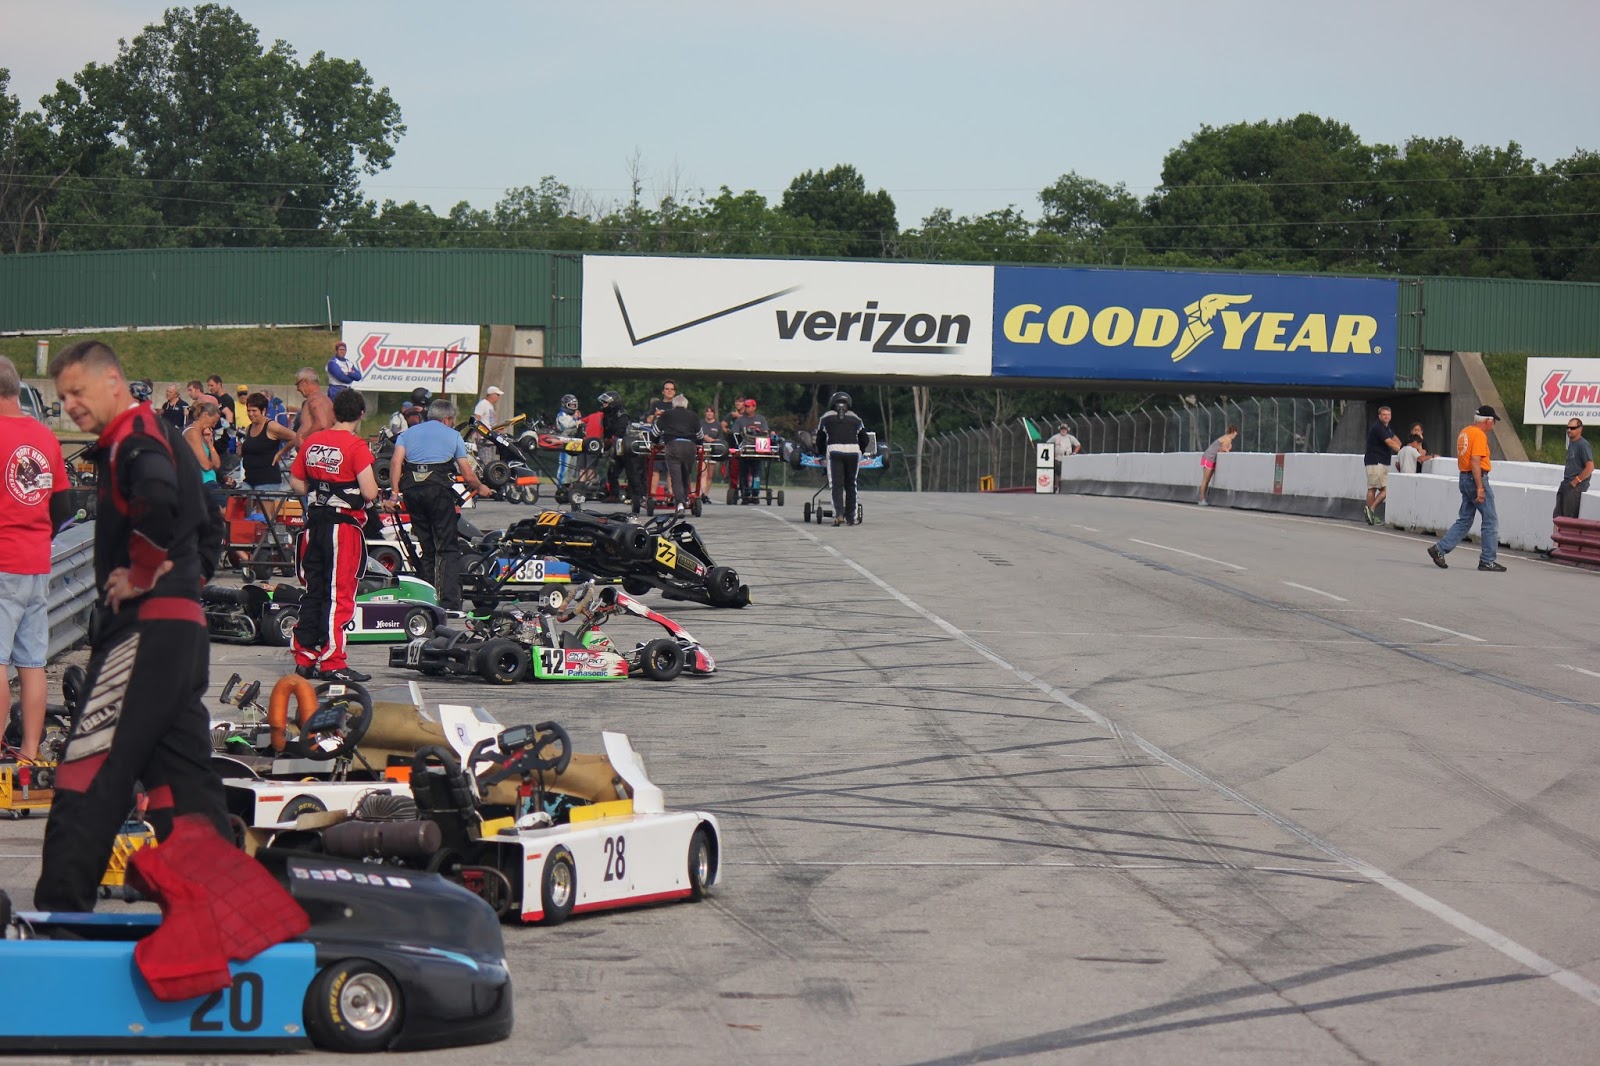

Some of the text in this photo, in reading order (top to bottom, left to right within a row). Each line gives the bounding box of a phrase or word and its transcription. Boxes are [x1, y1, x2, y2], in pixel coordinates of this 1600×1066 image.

[776, 301, 971, 353] verizon
[358, 333, 462, 376] SUMMIT
[1542, 372, 1600, 412] SUM
[1041, 448, 1050, 461] 4
[375, 619, 400, 629] Hoosier
[541, 649, 564, 674] 42
[567, 669, 608, 677] Panasonic
[81, 706, 115, 731] BELL
[603, 835, 626, 882] 28
[189, 972, 264, 1032] 20
[329, 971, 348, 1024] DUNLOP
